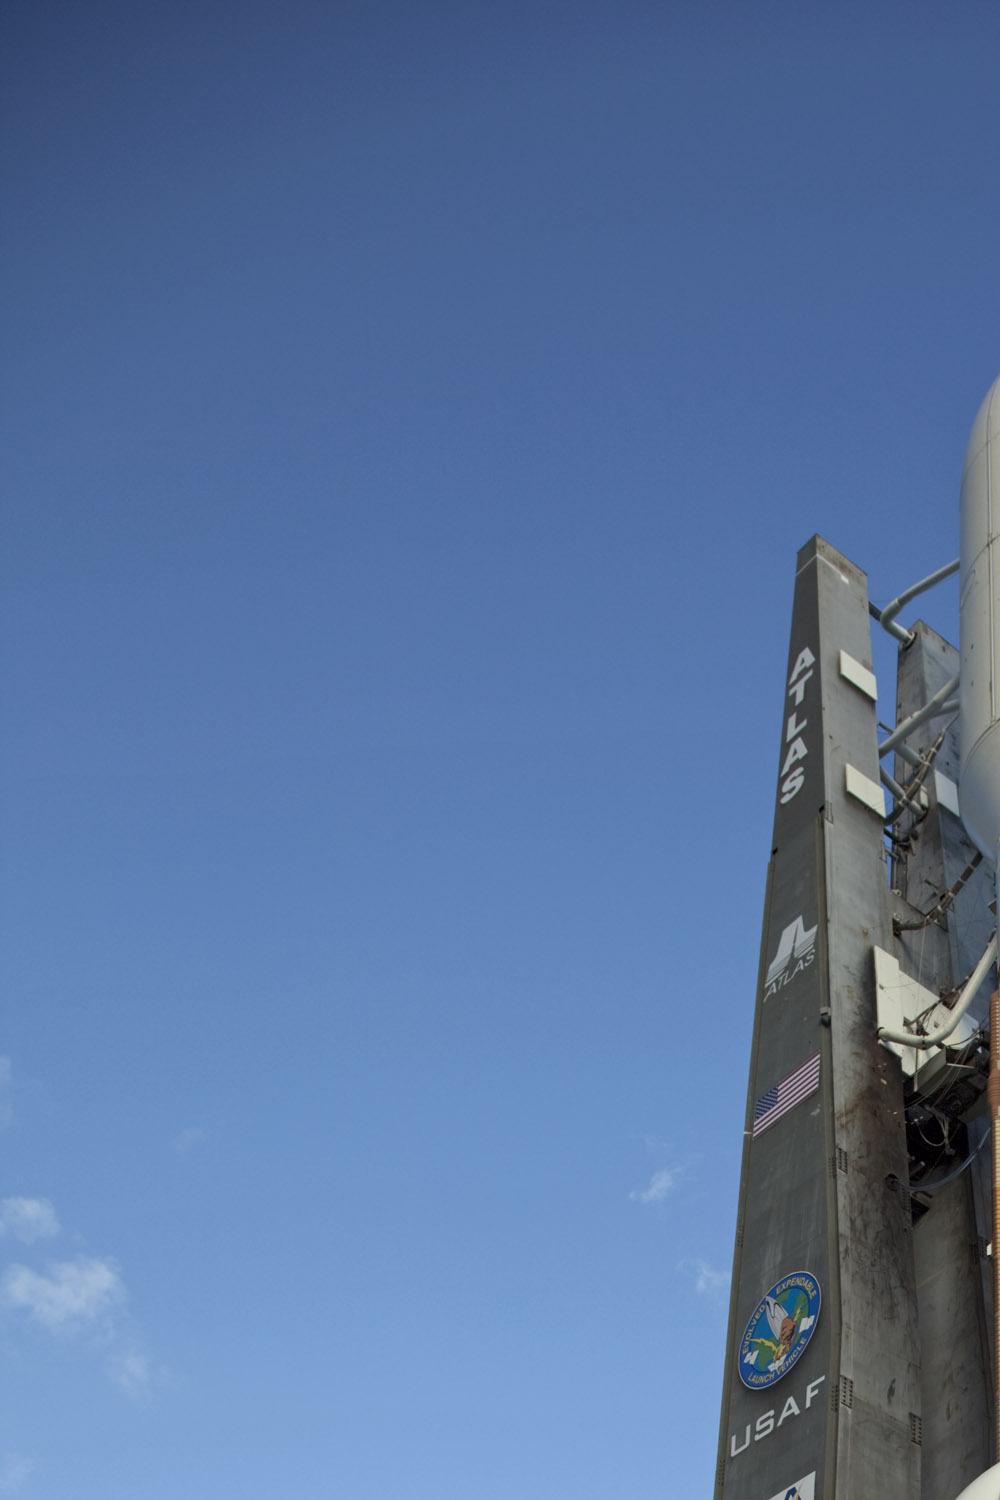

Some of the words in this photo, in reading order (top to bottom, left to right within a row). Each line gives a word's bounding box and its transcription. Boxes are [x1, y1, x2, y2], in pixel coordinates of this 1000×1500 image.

[780, 646, 816, 804] ATLAS
[763, 949, 815, 1003] ATLAS
[742, 1304, 766, 1355] EVOLVED
[775, 1277, 817, 1299] EXPENDABLE
[747, 1372, 775, 1385] LAUNCH
[776, 1337, 807, 1375] VEHICLE
[730, 1374, 825, 1457] USAF
